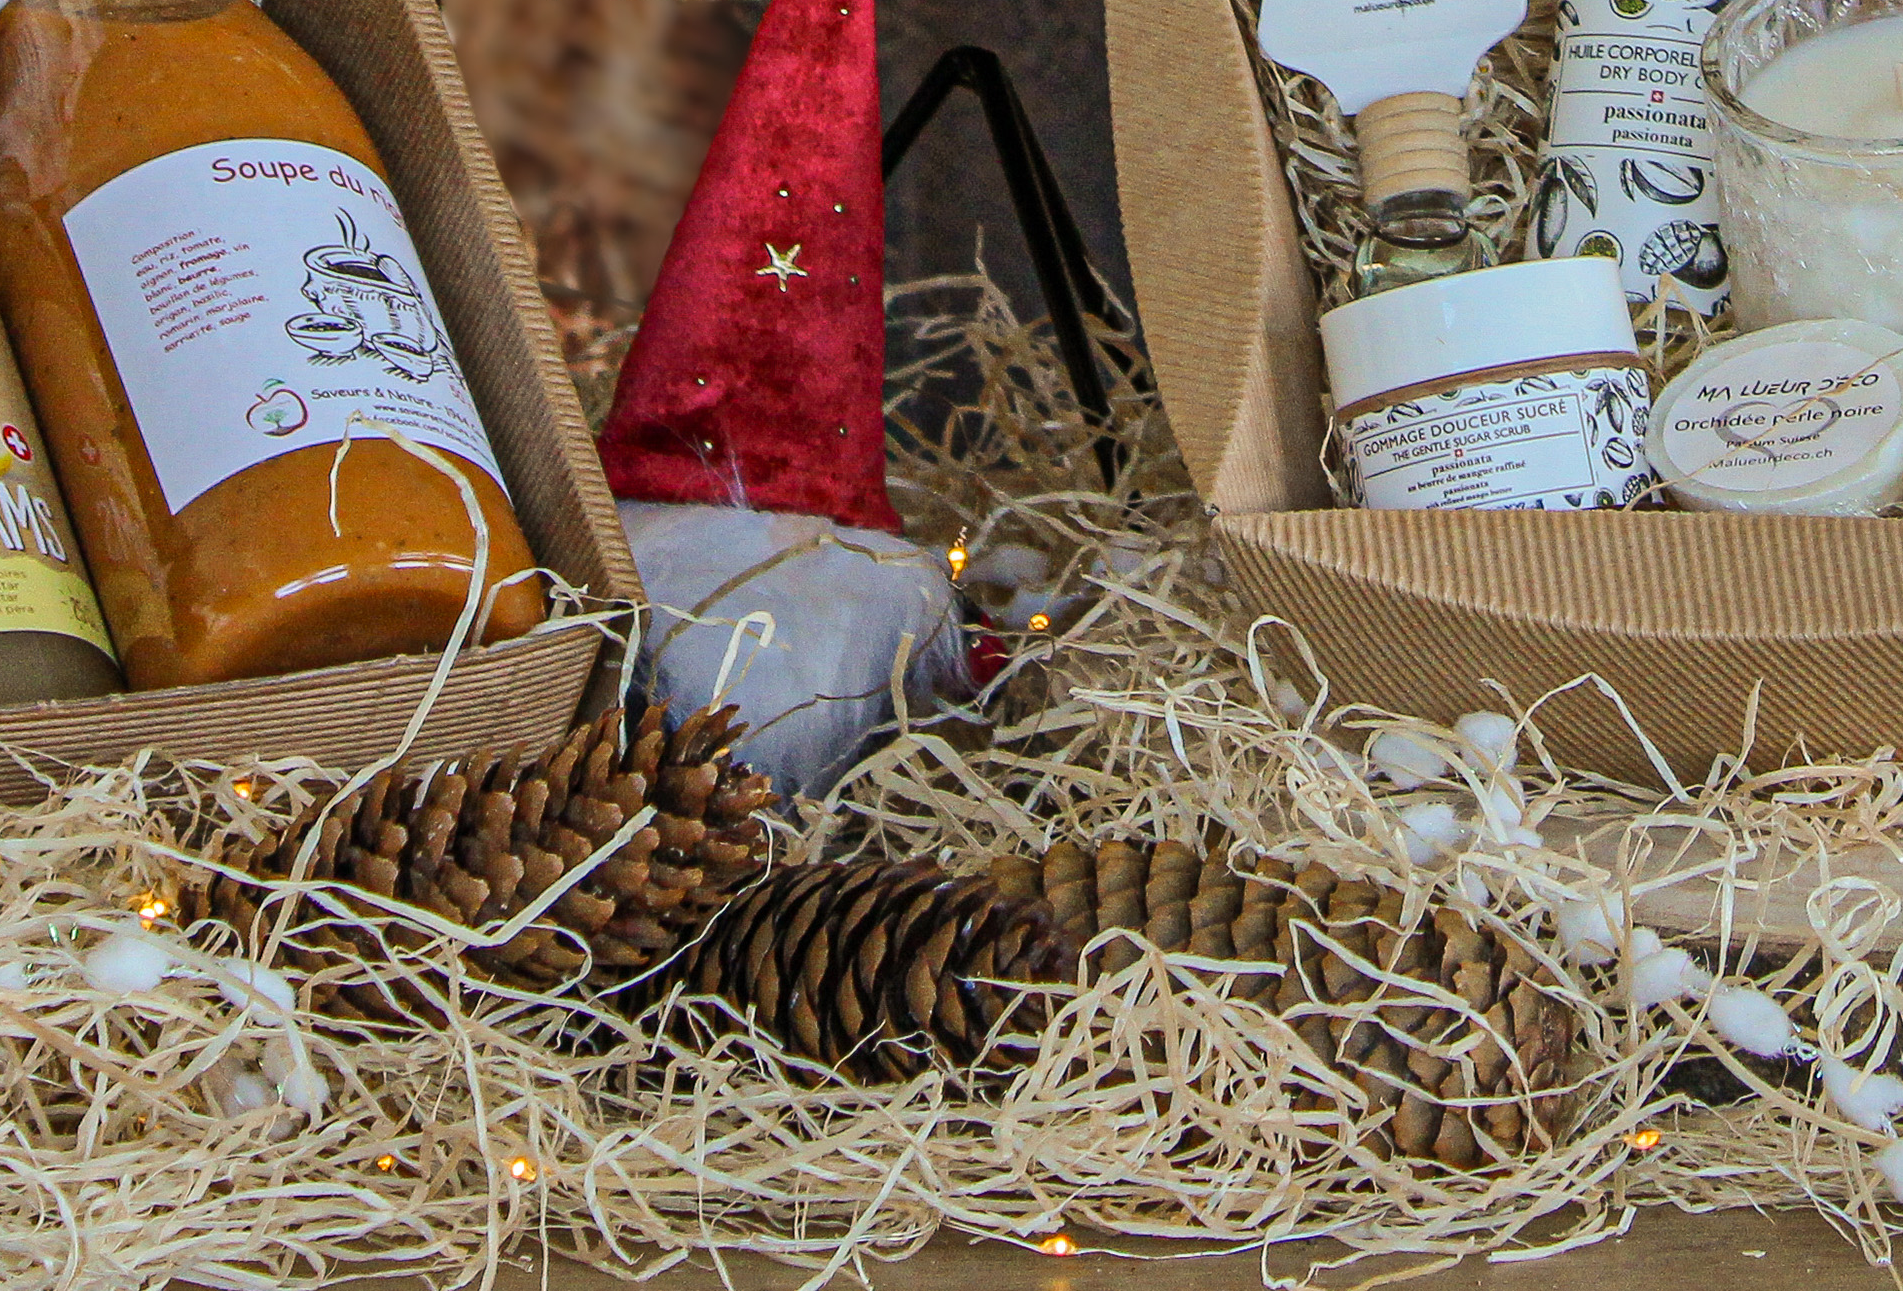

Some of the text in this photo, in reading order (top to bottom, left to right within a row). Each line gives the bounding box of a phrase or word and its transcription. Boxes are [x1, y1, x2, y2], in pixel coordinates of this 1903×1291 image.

[1568, 43, 1699, 68] HUILE CORPOREL
[1599, 64, 1633, 80] DRY
[1637, 67, 1689, 86] BODY
[1603, 103, 1707, 131] passionata
[1612, 127, 1694, 149] passionata
[212, 157, 365, 197] Soupe du
[131, 229, 196, 266] Composition
[232, 242, 251, 253] vin
[192, 282, 207, 294] de
[311, 387, 433, 410] Saveurs & Nature
[1697, 378, 1812, 404] MA LUEUR
[1363, 398, 1568, 458] GOMMAGE DOUCEUR SUCRÉ
[1674, 413, 1766, 433] Orchidée
[1830, 404, 1884, 420] noire
[1392, 423, 1532, 463] THE GENTLE SUGAR SCRUB
[1779, 432, 1821, 447] Suisse
[1431, 453, 1494, 478] passionata
[1708, 448, 1834, 471] Malueurdeco.ch
[1416, 476, 1446, 493] beurre
[1446, 473, 1458, 484] de
[1458, 466, 1494, 484] mangue
[1442, 480, 1490, 499] passionata
[5, 603, 36, 617] pera
